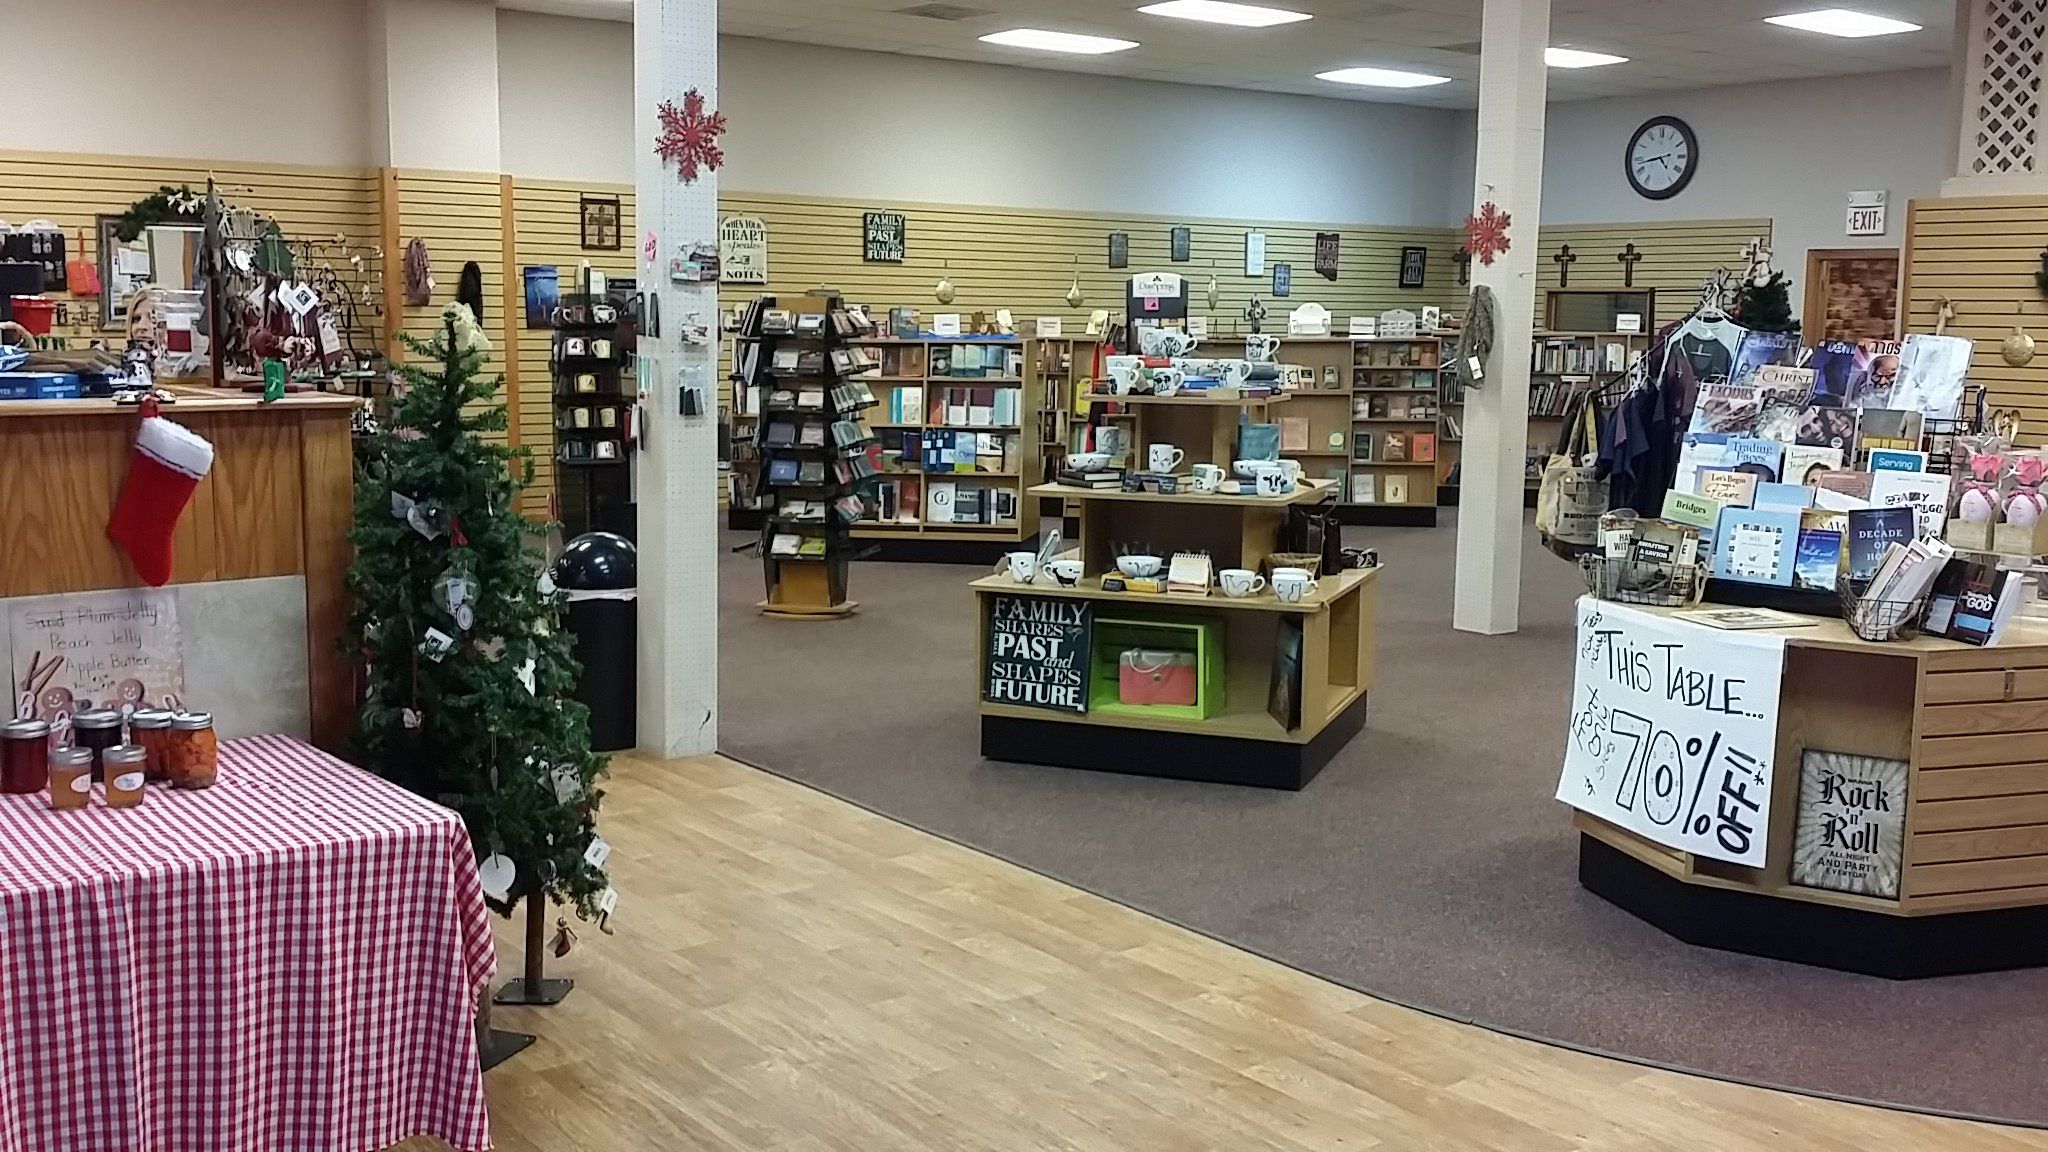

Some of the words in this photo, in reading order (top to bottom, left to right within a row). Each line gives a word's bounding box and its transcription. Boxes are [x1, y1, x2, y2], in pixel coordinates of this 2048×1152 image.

[725, 220, 743, 229] WHEN
[745, 220, 761, 229] YOUR
[867, 214, 904, 226] FAMILY
[1853, 211, 1878, 230] EXIT
[722, 229, 766, 242] HEART
[869, 230, 896, 242] PAST
[1318, 241, 1338, 250] LIFE
[868, 250, 903, 260] FUTURE
[1316, 260, 1337, 269] FARM
[726, 271, 763, 279] NOTES
[1762, 370, 1812, 383] CHRIST
[1732, 441, 1774, 455] Trading
[1878, 457, 1913, 470] Serving
[1676, 500, 1707, 514] Bridges
[1859, 529, 1904, 539] DECADE
[1645, 550, 1668, 559] SAVIOR
[1967, 597, 1992, 611] GOD
[994, 598, 1090, 626] FAMILY
[995, 619, 1064, 637] SHARES
[49, 631, 92, 650] Peach
[106, 629, 142, 649] Jelly
[998, 632, 1064, 661] PAST
[64, 657, 103, 681] Apple
[110, 653, 150, 670] Butter
[1043, 651, 1075, 669] and
[991, 661, 1082, 686] SHAPES
[995, 679, 1082, 709] FUTURE
[1611, 708, 1721, 835] 70%
[1811, 769, 1889, 812] Rock
[1818, 813, 1878, 854] Roll
[1829, 851, 1843, 859] ALL
[1818, 857, 1841, 868] AND
[1845, 861, 1878, 873] PARTY
[1827, 868, 1867, 878] EVERYDAY
